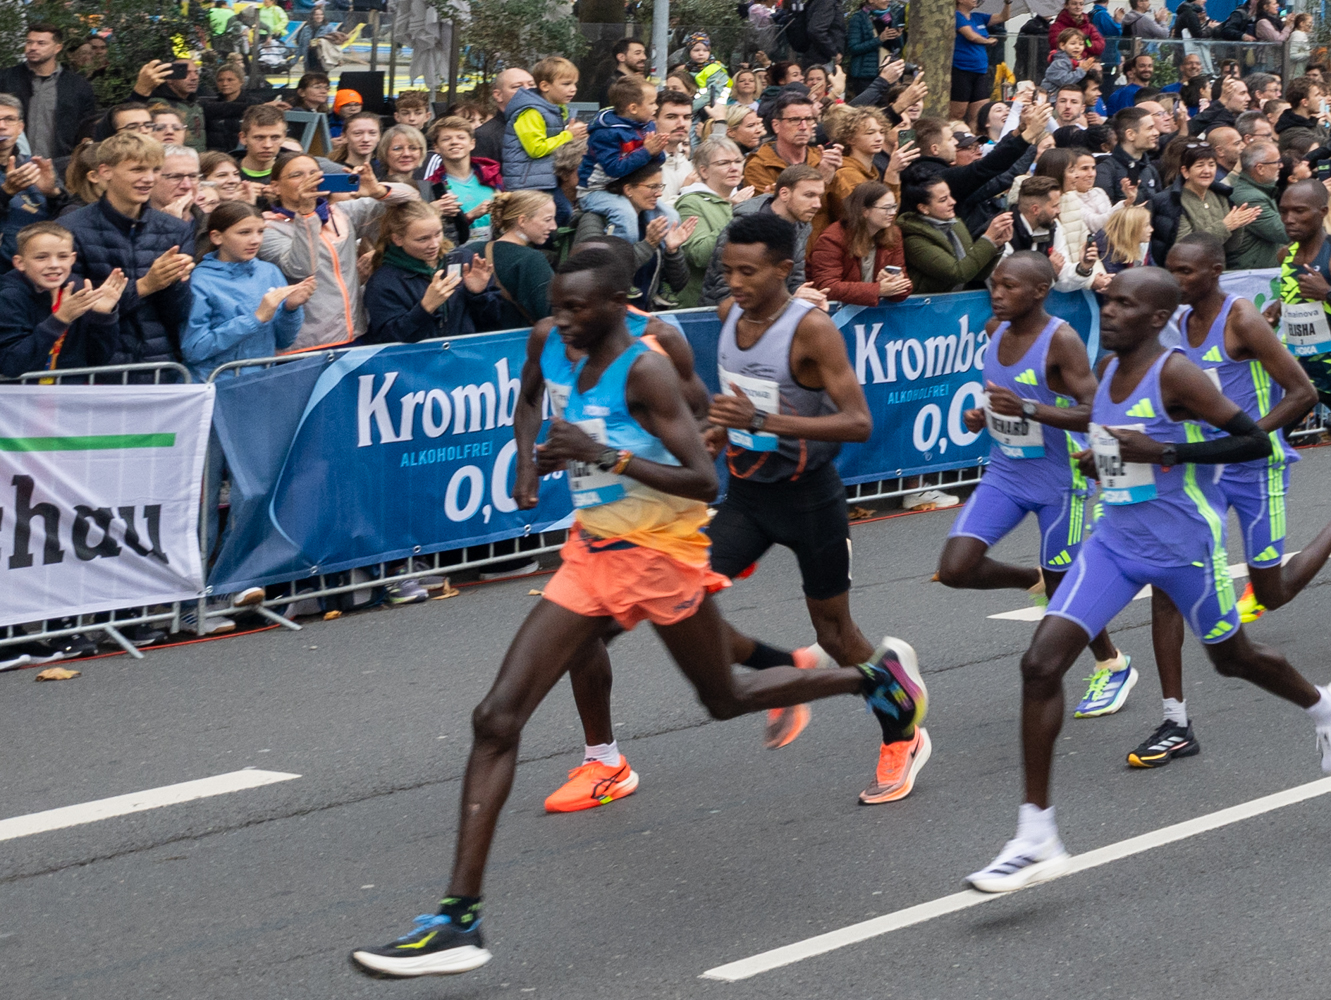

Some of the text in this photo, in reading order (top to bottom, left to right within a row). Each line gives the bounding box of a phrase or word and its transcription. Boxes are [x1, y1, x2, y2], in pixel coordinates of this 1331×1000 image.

[1288, 322, 1316, 336] ELISHA
[357, 357, 523, 448] Kromb
[887, 383, 950, 405] ALKOHOLFREI
[401, 440, 493, 468] ALKOHOLFREI
[0, 474, 169, 570] hau
